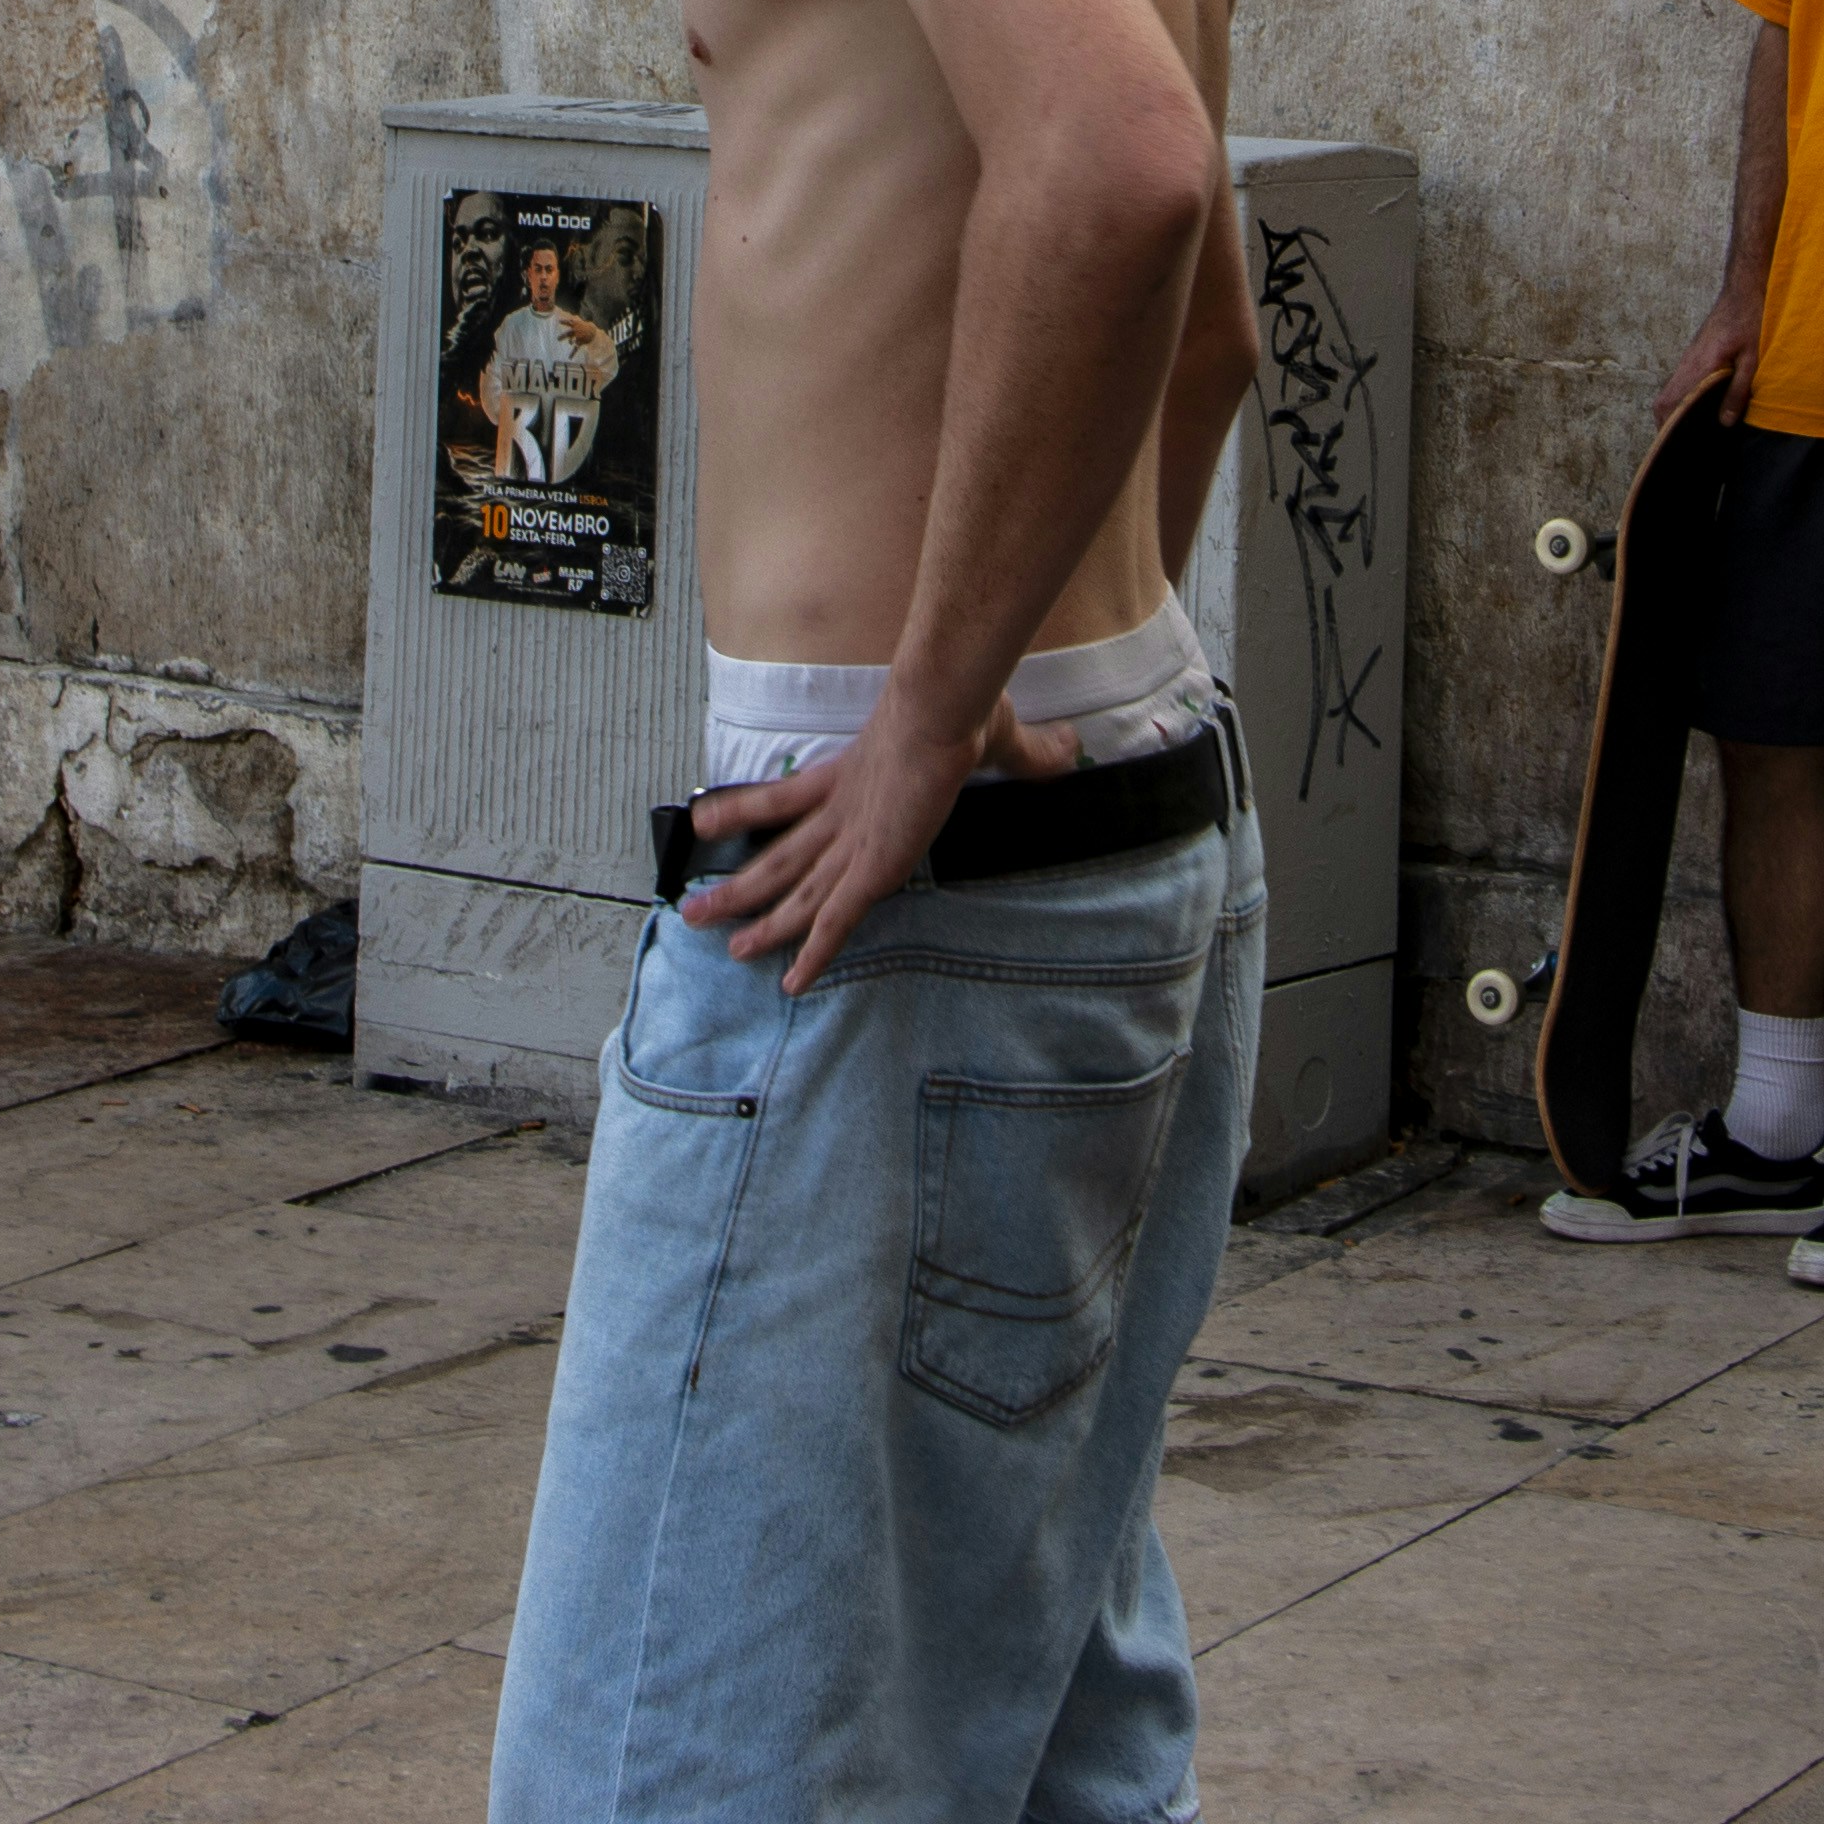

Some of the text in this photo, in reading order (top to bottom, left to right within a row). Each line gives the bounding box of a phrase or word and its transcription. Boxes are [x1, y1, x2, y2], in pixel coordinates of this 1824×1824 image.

[517, 212, 591, 230] MAD DOG
[501, 359, 602, 401] MAJOR
[495, 391, 601, 484] RD
[505, 486, 546, 500] PRIMEIRA
[548, 491, 564, 503] VEZ
[564, 492, 578, 504] EM
[579, 495, 609, 507] LISBOA
[480, 502, 610, 540] 10 NOVEMBRO
[509, 528, 577, 547] SEXTA-FEIRA
